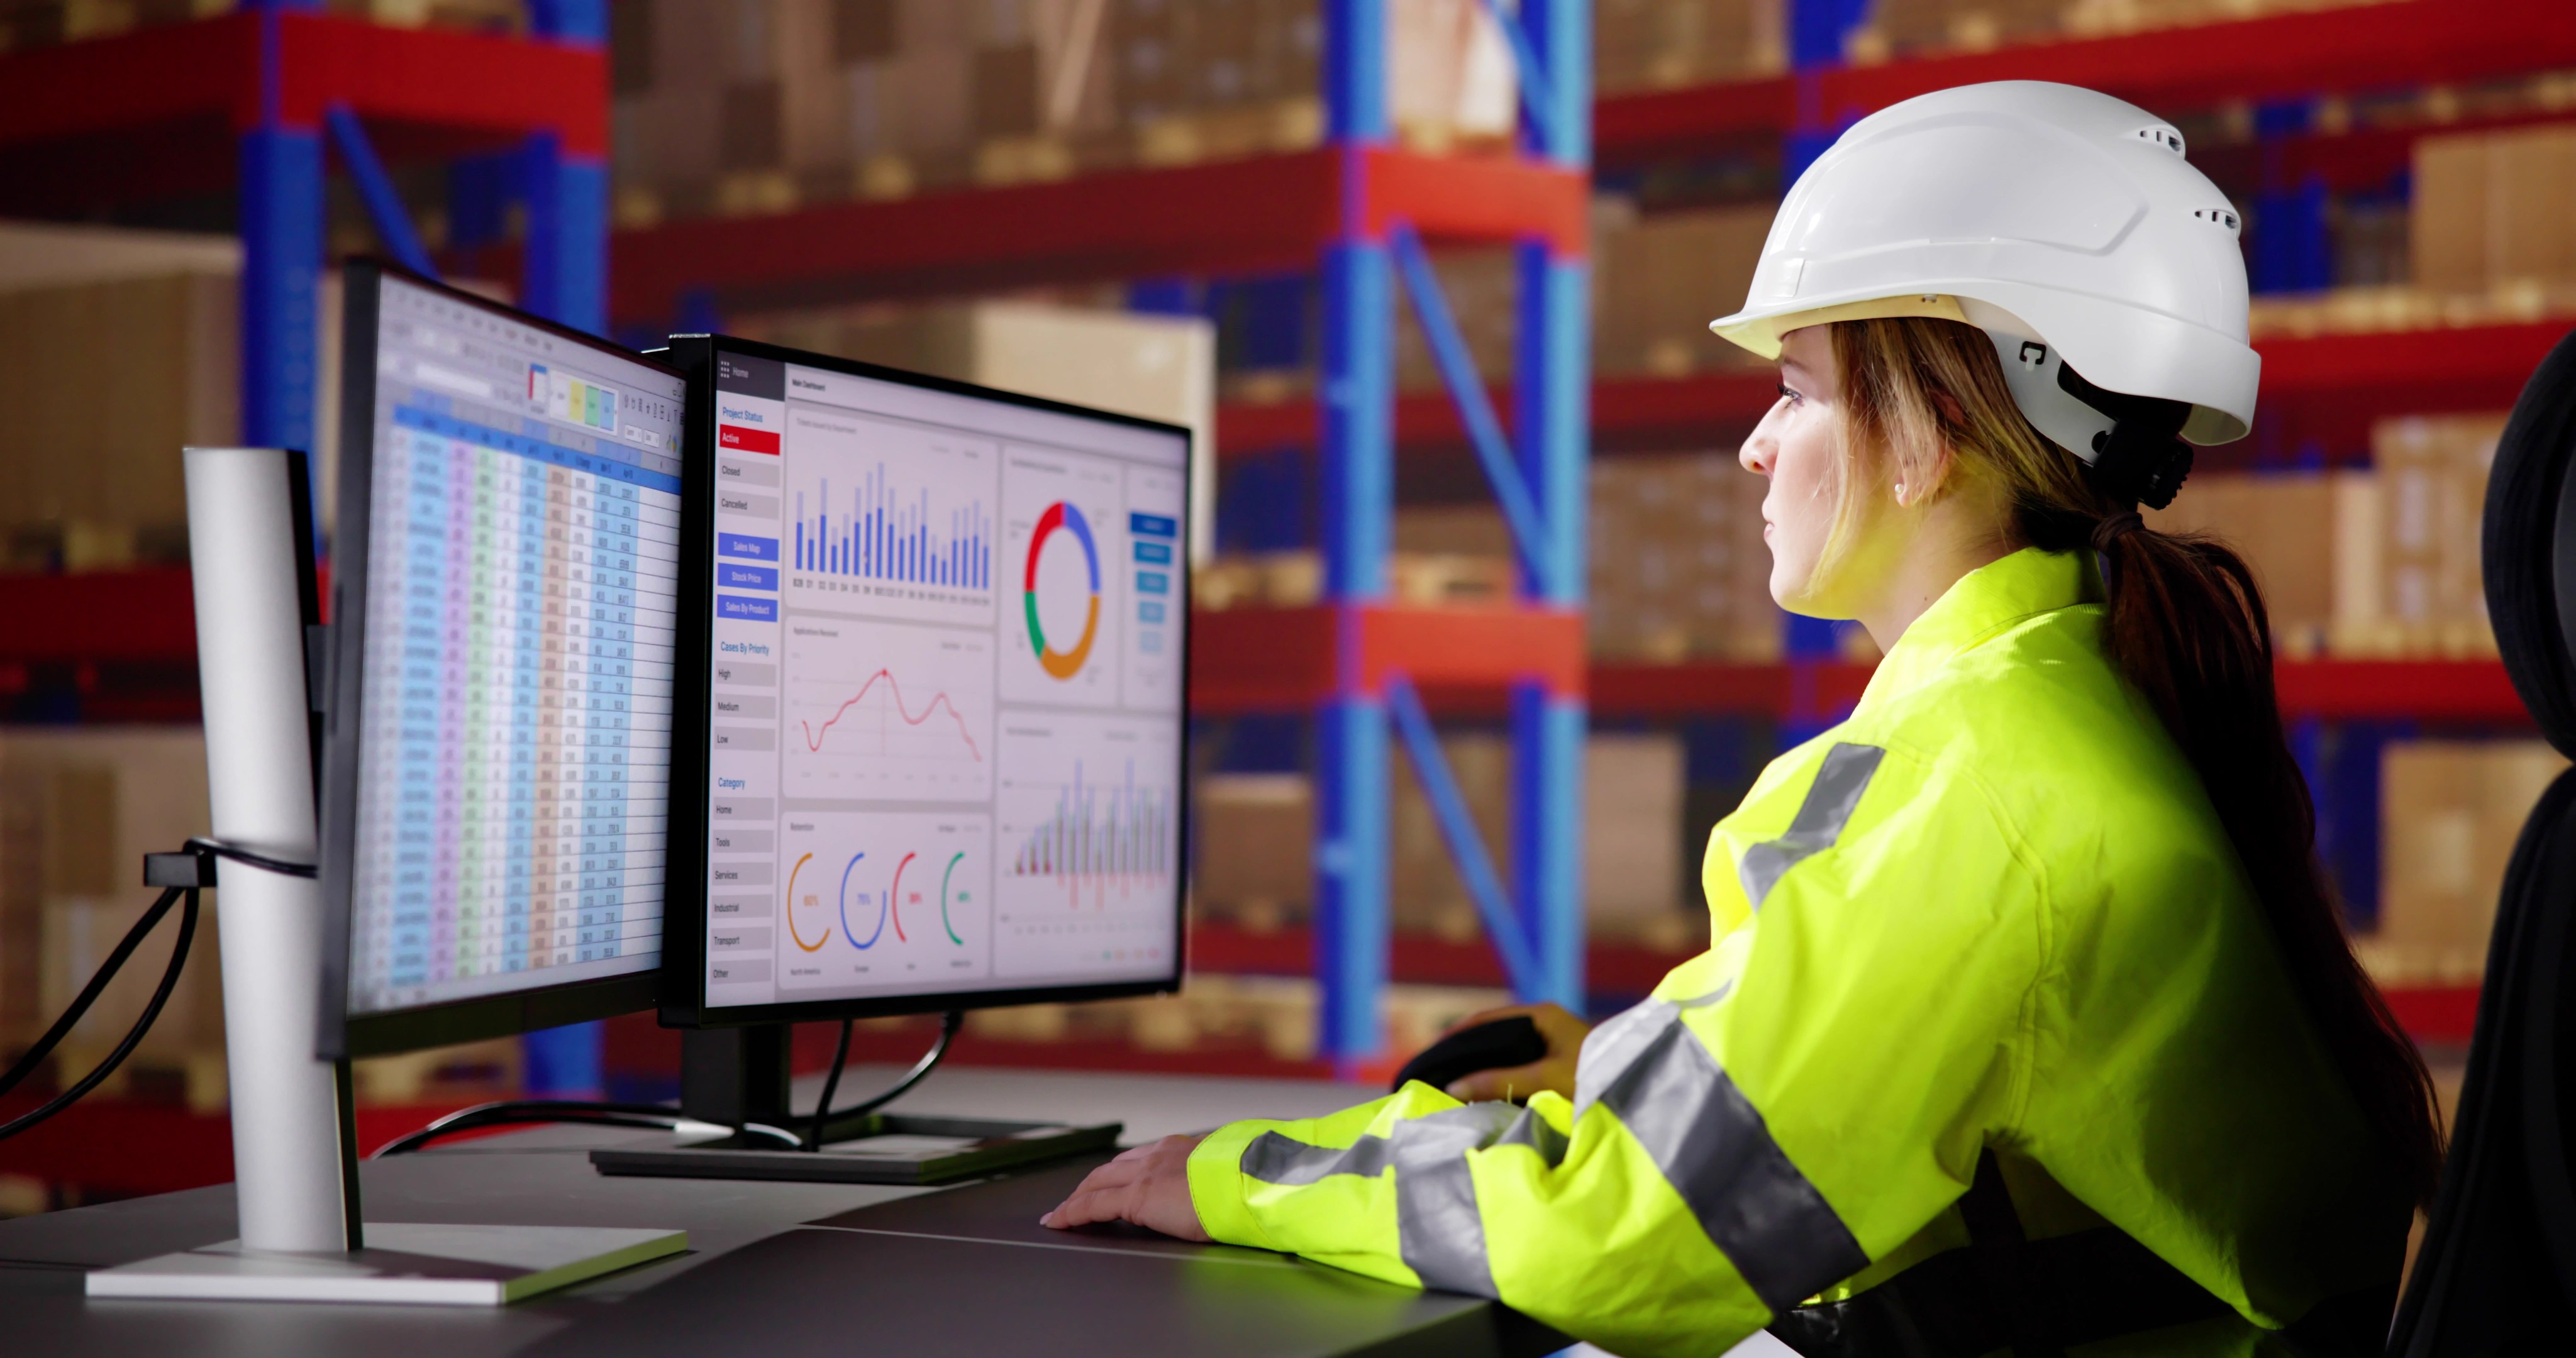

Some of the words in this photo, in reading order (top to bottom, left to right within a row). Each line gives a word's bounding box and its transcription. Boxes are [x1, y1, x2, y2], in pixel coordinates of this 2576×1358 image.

[733, 367, 748, 378] Home
[723, 406, 743, 420] Project
[744, 411, 763, 423] Status
[722, 432, 740, 444] Active
[721, 465, 741, 476] Closed
[721, 498, 748, 510] Cancelled
[733, 541, 748, 552] Sales
[748, 543, 760, 555] Map
[731, 571, 747, 582] Stock
[748, 573, 762, 583] Price
[726, 602, 740, 612] Sales
[741, 604, 748, 615] By
[748, 604, 769, 614] Product
[721, 641, 739, 652] Cases
[740, 643, 747, 654] By
[748, 644, 769, 656] Priority
[718, 669, 731, 680] High
[718, 702, 739, 711] Medium
[717, 735, 728, 744] Low
[718, 777, 745, 790] Category
[716, 805, 732, 814] Home
[716, 838, 730, 846] Tools
[715, 871, 738, 880] Services
[714, 903, 739, 912] Industrial
[714, 936, 740, 946] Transport
[713, 969, 728, 978] Other
